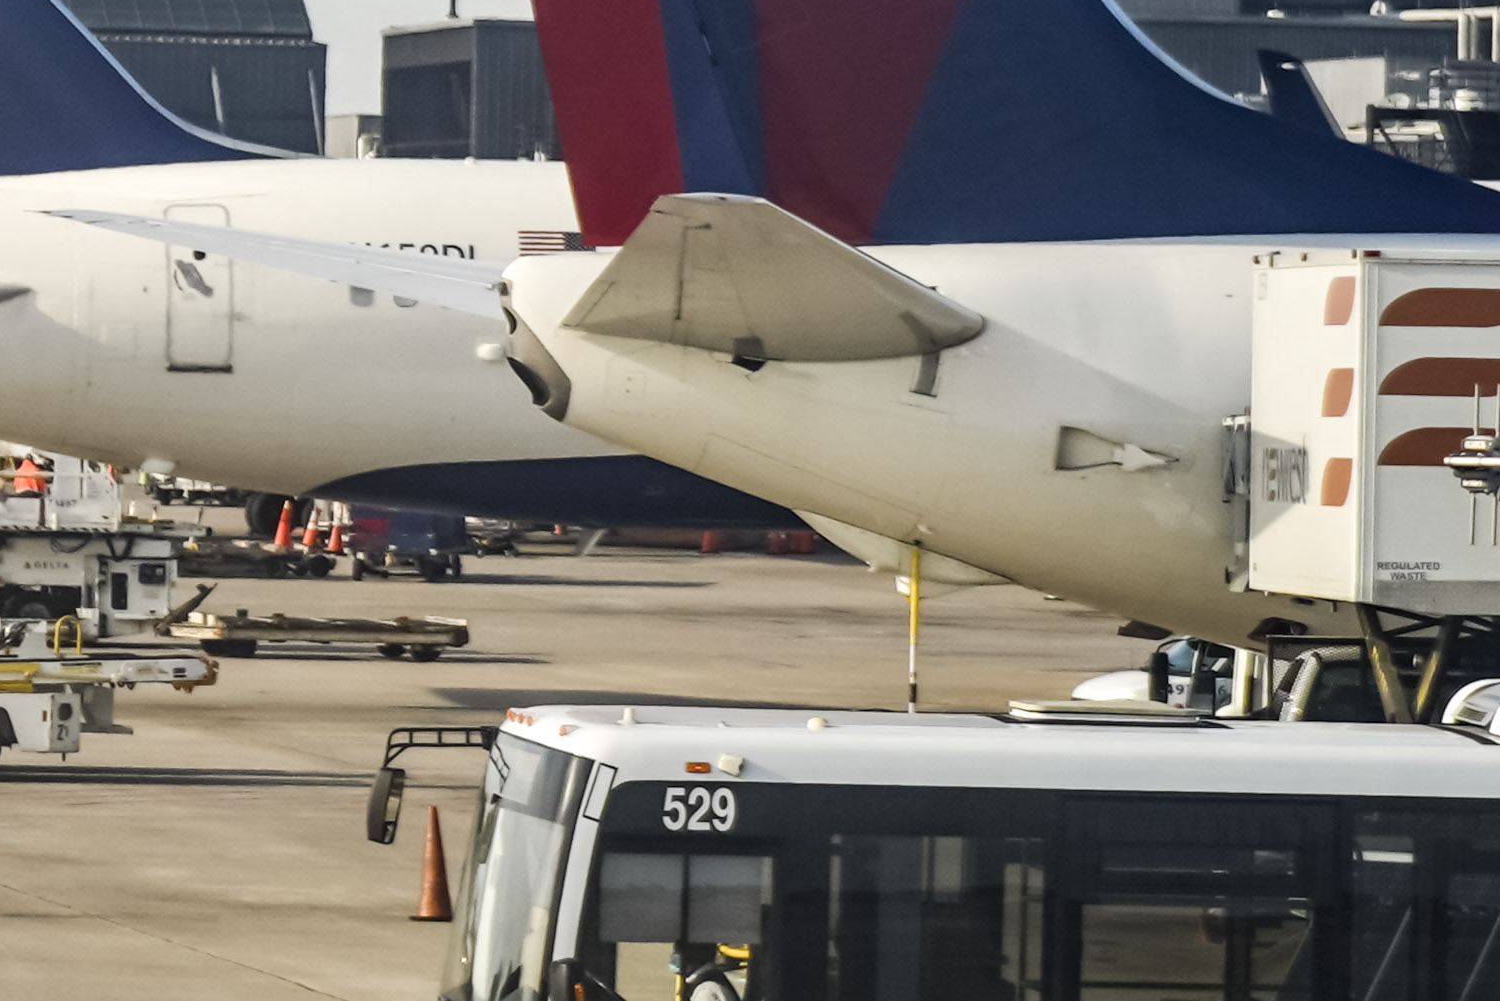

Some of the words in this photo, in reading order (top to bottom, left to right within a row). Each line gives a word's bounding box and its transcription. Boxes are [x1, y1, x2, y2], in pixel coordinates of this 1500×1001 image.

[1376, 561, 1441, 571] REGULATED
[1390, 571, 1428, 581] WASTE
[661, 786, 736, 832] 529
